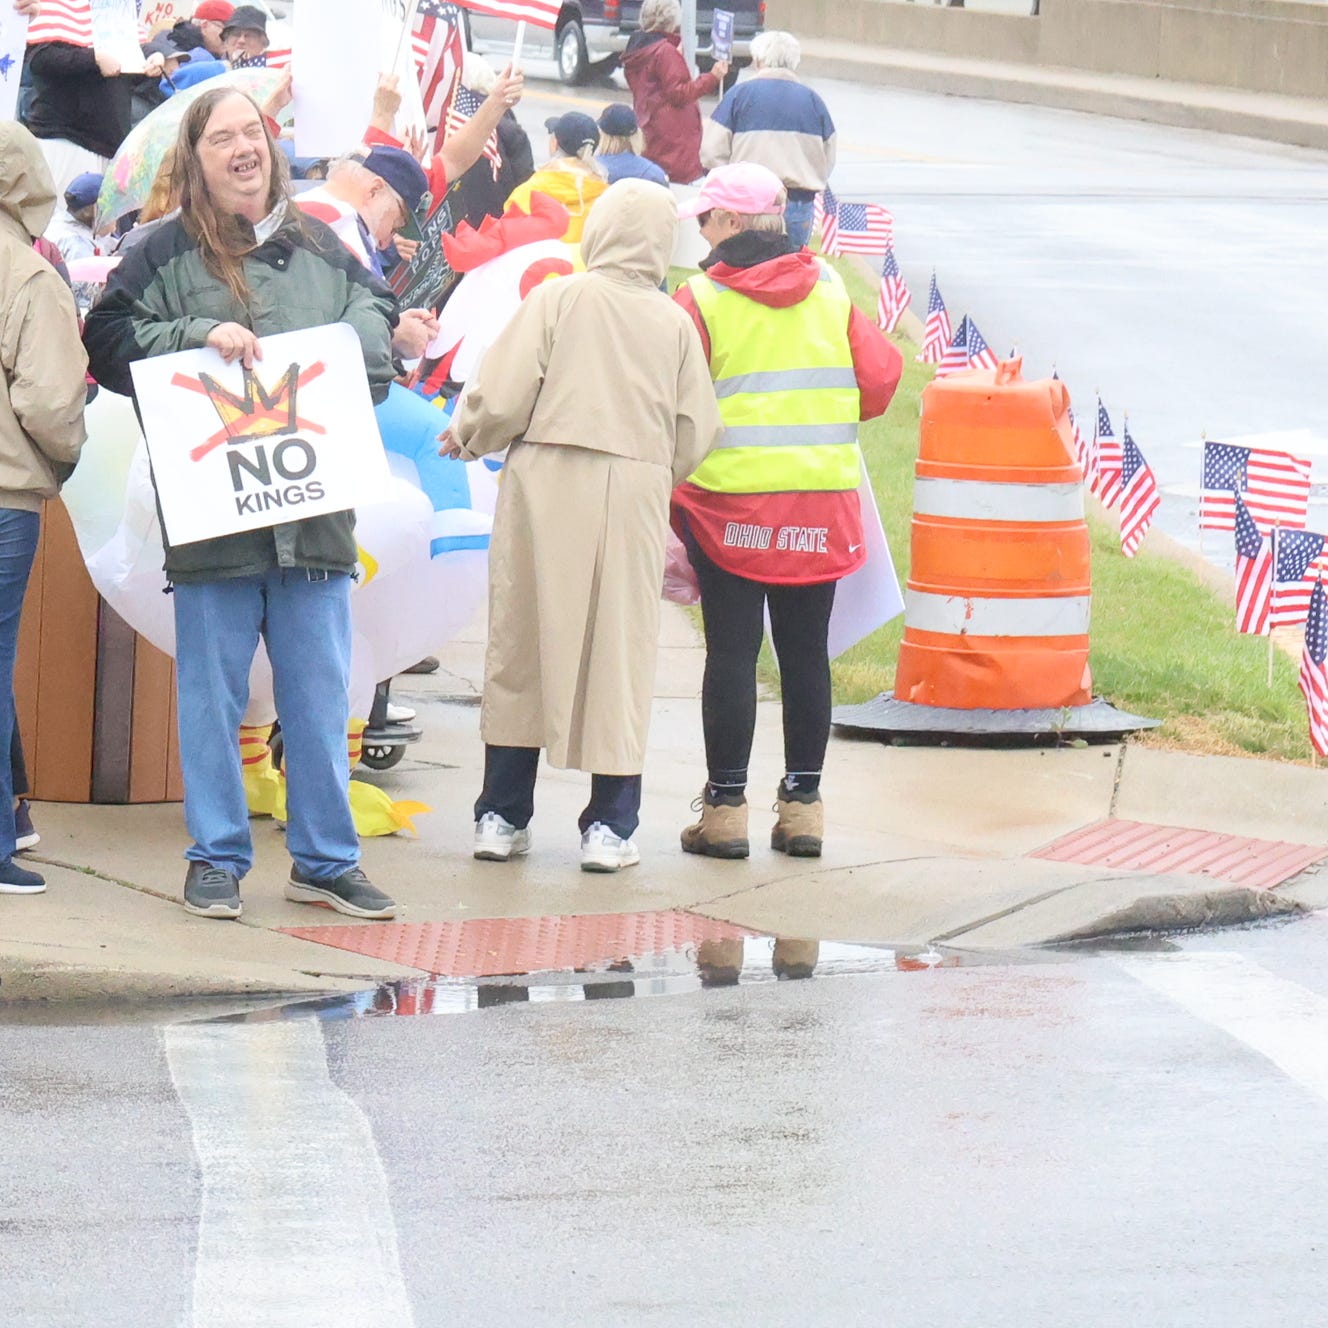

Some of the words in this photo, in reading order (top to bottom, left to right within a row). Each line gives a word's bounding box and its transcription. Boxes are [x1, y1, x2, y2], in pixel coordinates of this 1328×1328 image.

[156, 2, 174, 16] NO
[226, 437, 317, 493] NO
[235, 480, 326, 516] KINGS
[723, 521, 773, 550] OHIO
[776, 525, 829, 554] STATE
